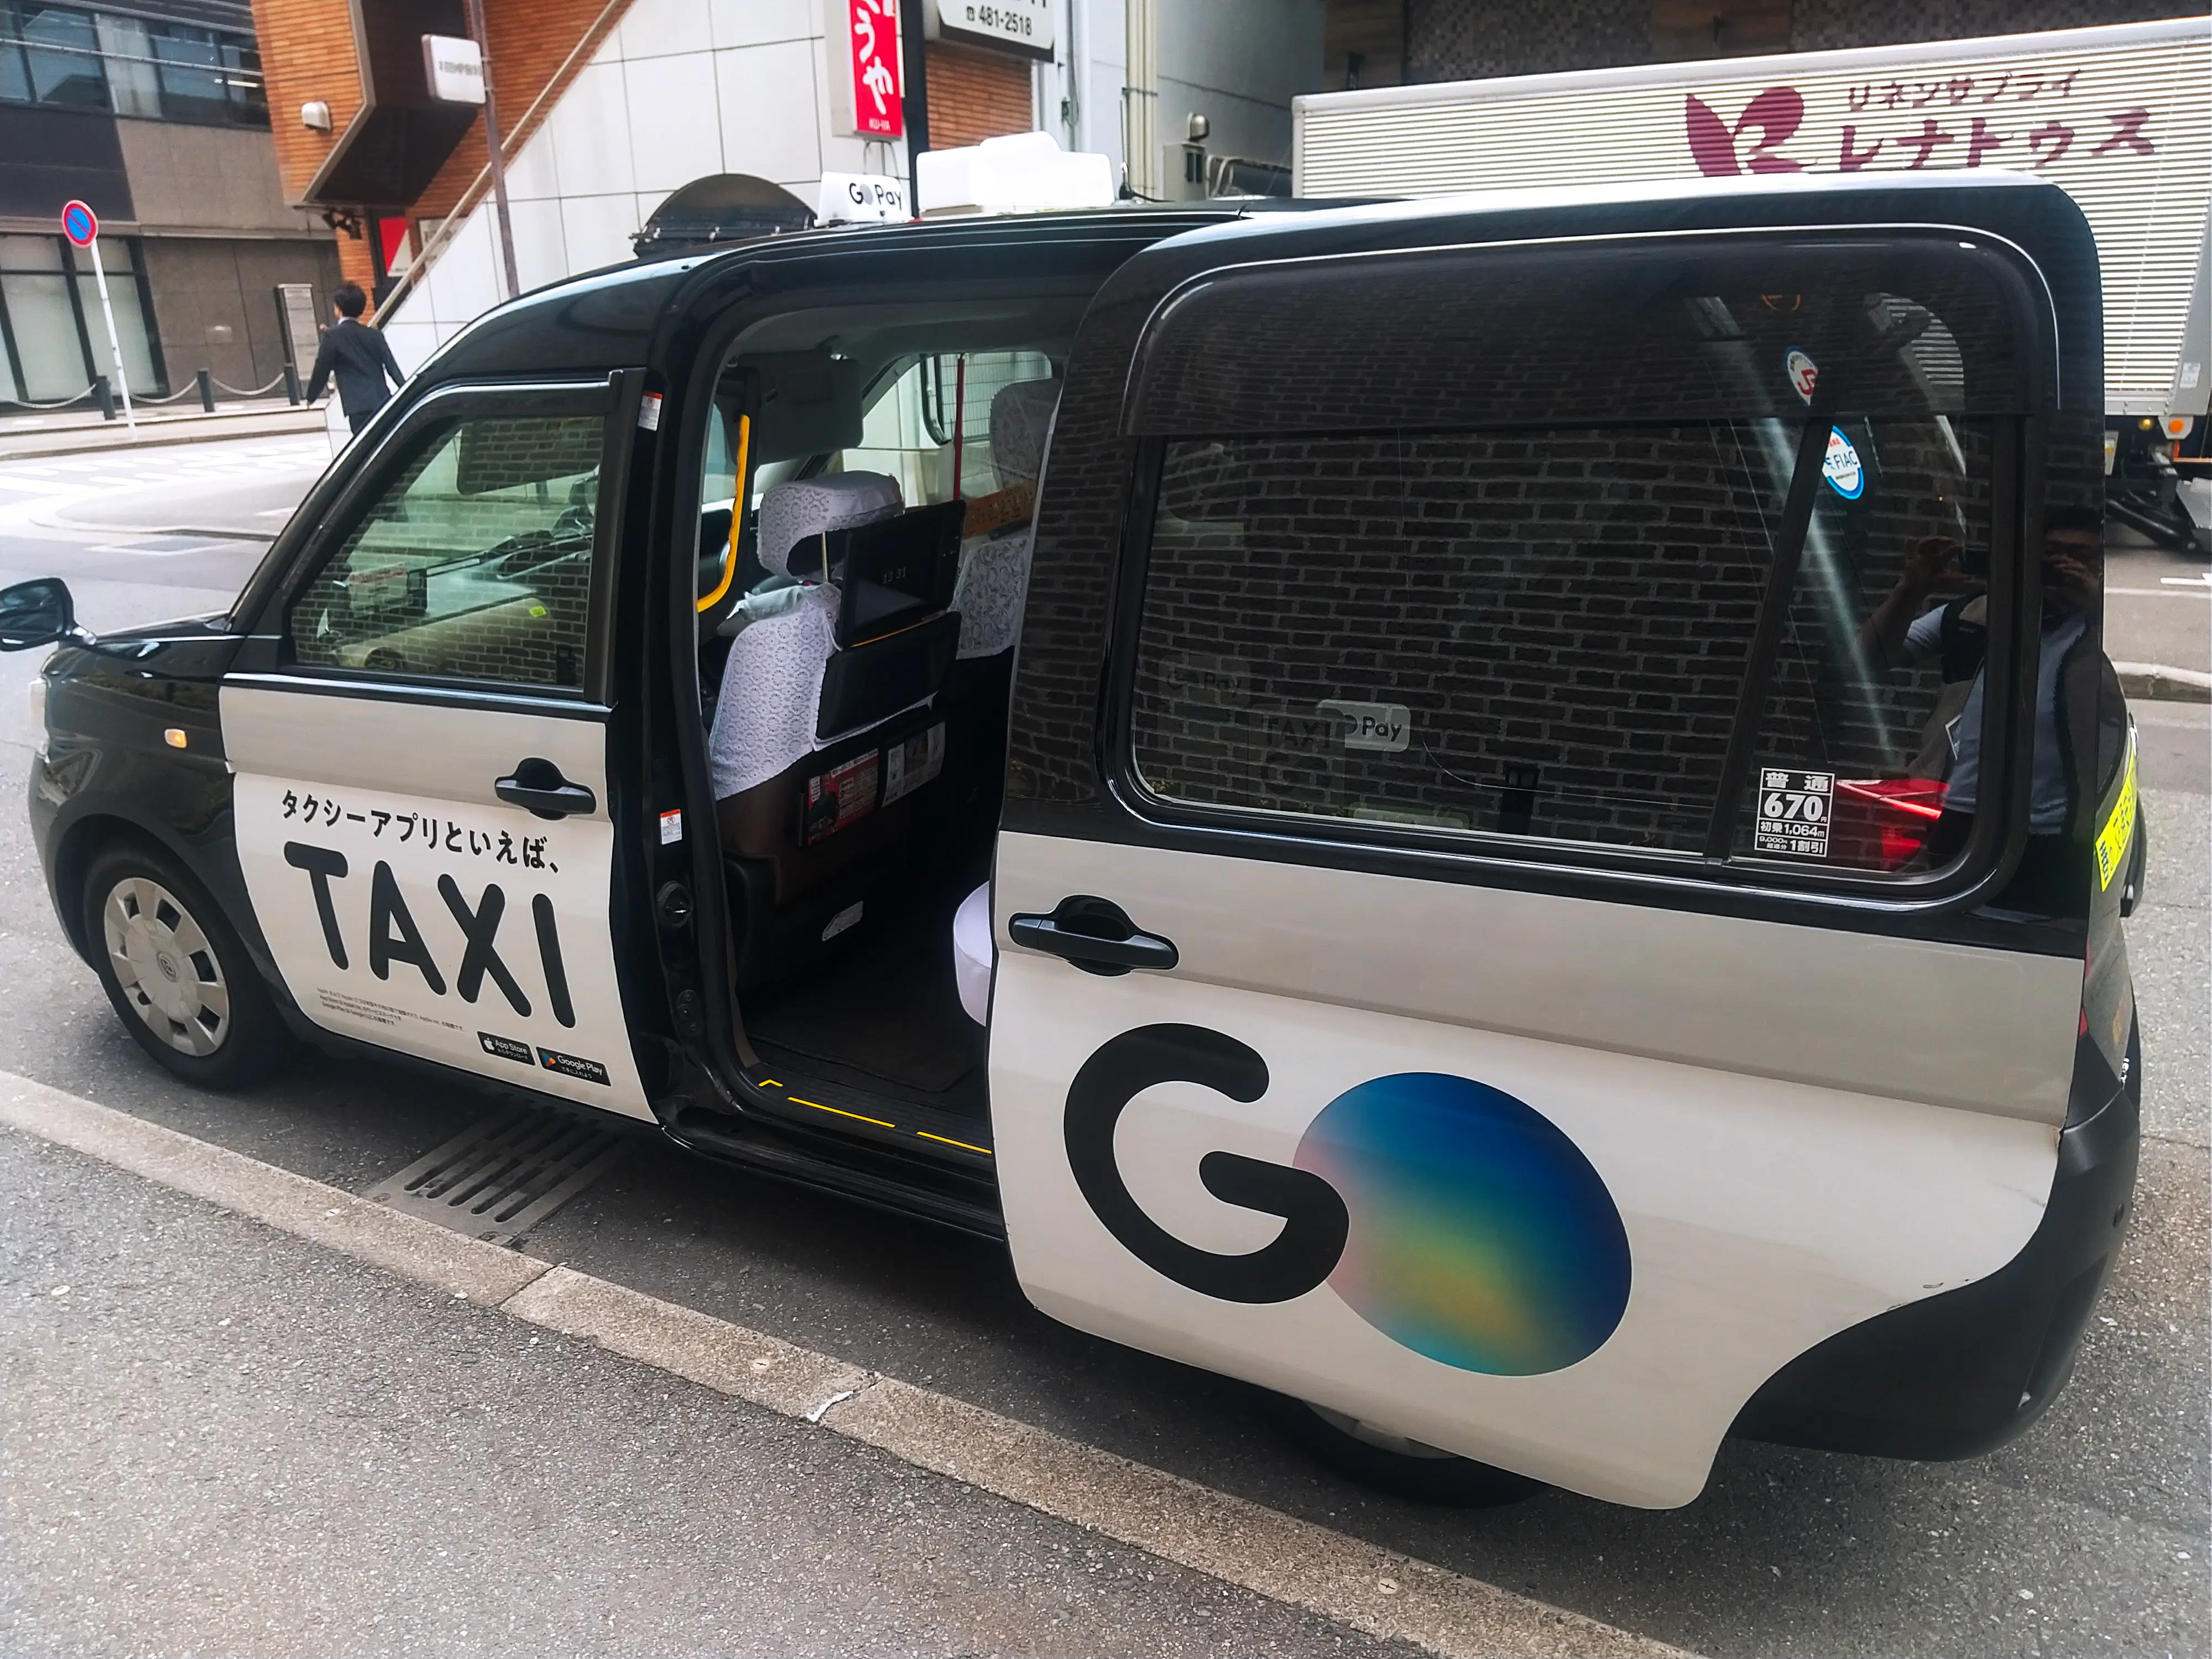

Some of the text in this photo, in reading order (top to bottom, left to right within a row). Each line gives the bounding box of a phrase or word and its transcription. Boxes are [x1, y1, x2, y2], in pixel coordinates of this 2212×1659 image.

[1848, 67, 2083, 110] リネンサプライ
[874, 184, 902, 211] Pay
[1362, 716, 1402, 742] Pay
[281, 790, 559, 873] タクシーアプリといえば、
[284, 841, 576, 1028] TAXI
[495, 1040, 528, 1055] App Store
[557, 1055, 603, 1076] Google Play
